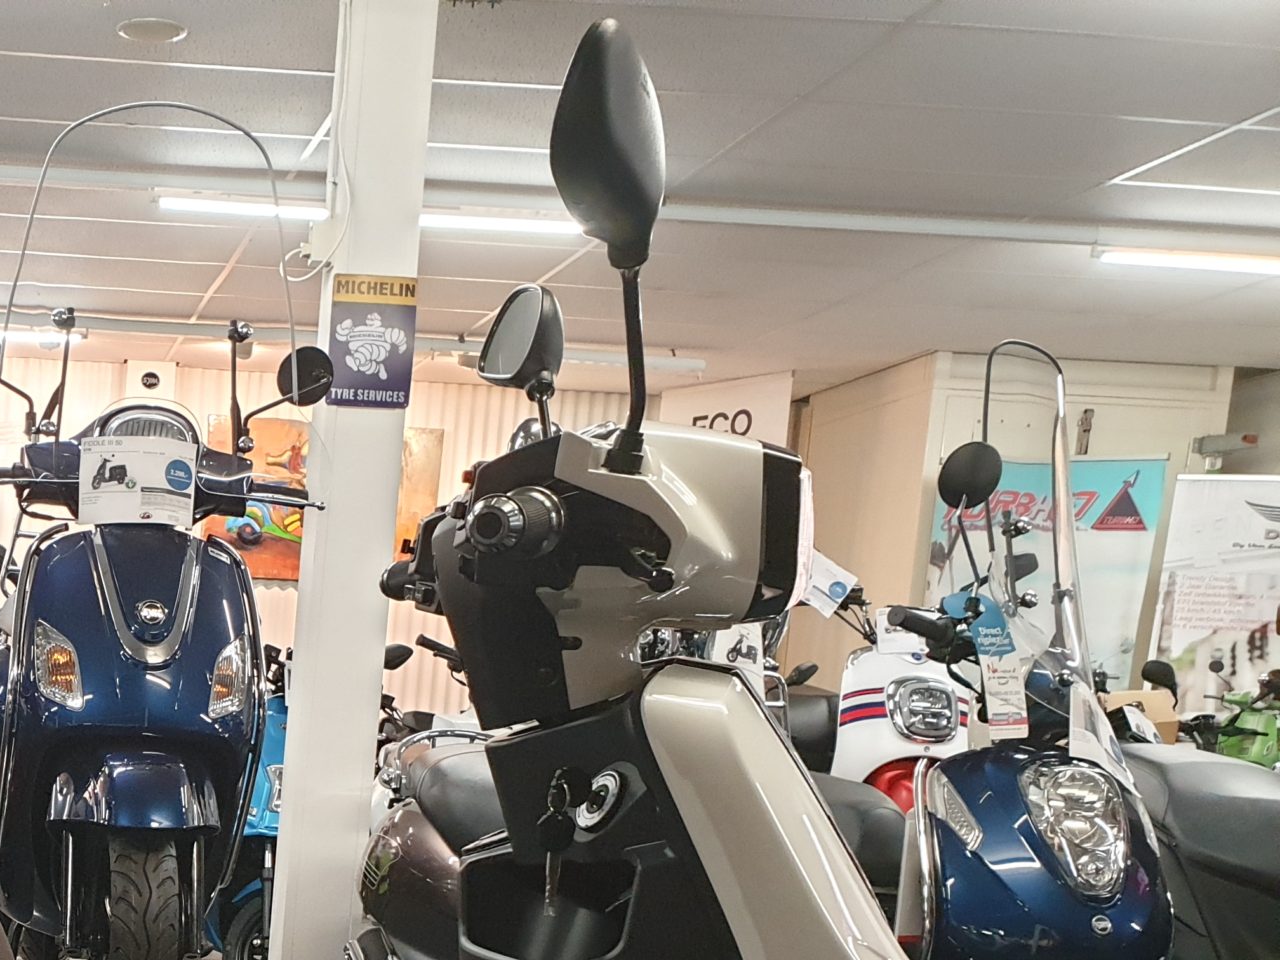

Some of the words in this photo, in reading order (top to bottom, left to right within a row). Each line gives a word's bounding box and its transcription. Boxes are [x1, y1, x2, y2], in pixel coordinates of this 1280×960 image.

[336, 280, 416, 298] MICHELIN
[330, 388, 356, 400] TYRE
[357, 389, 406, 403] SERVICES
